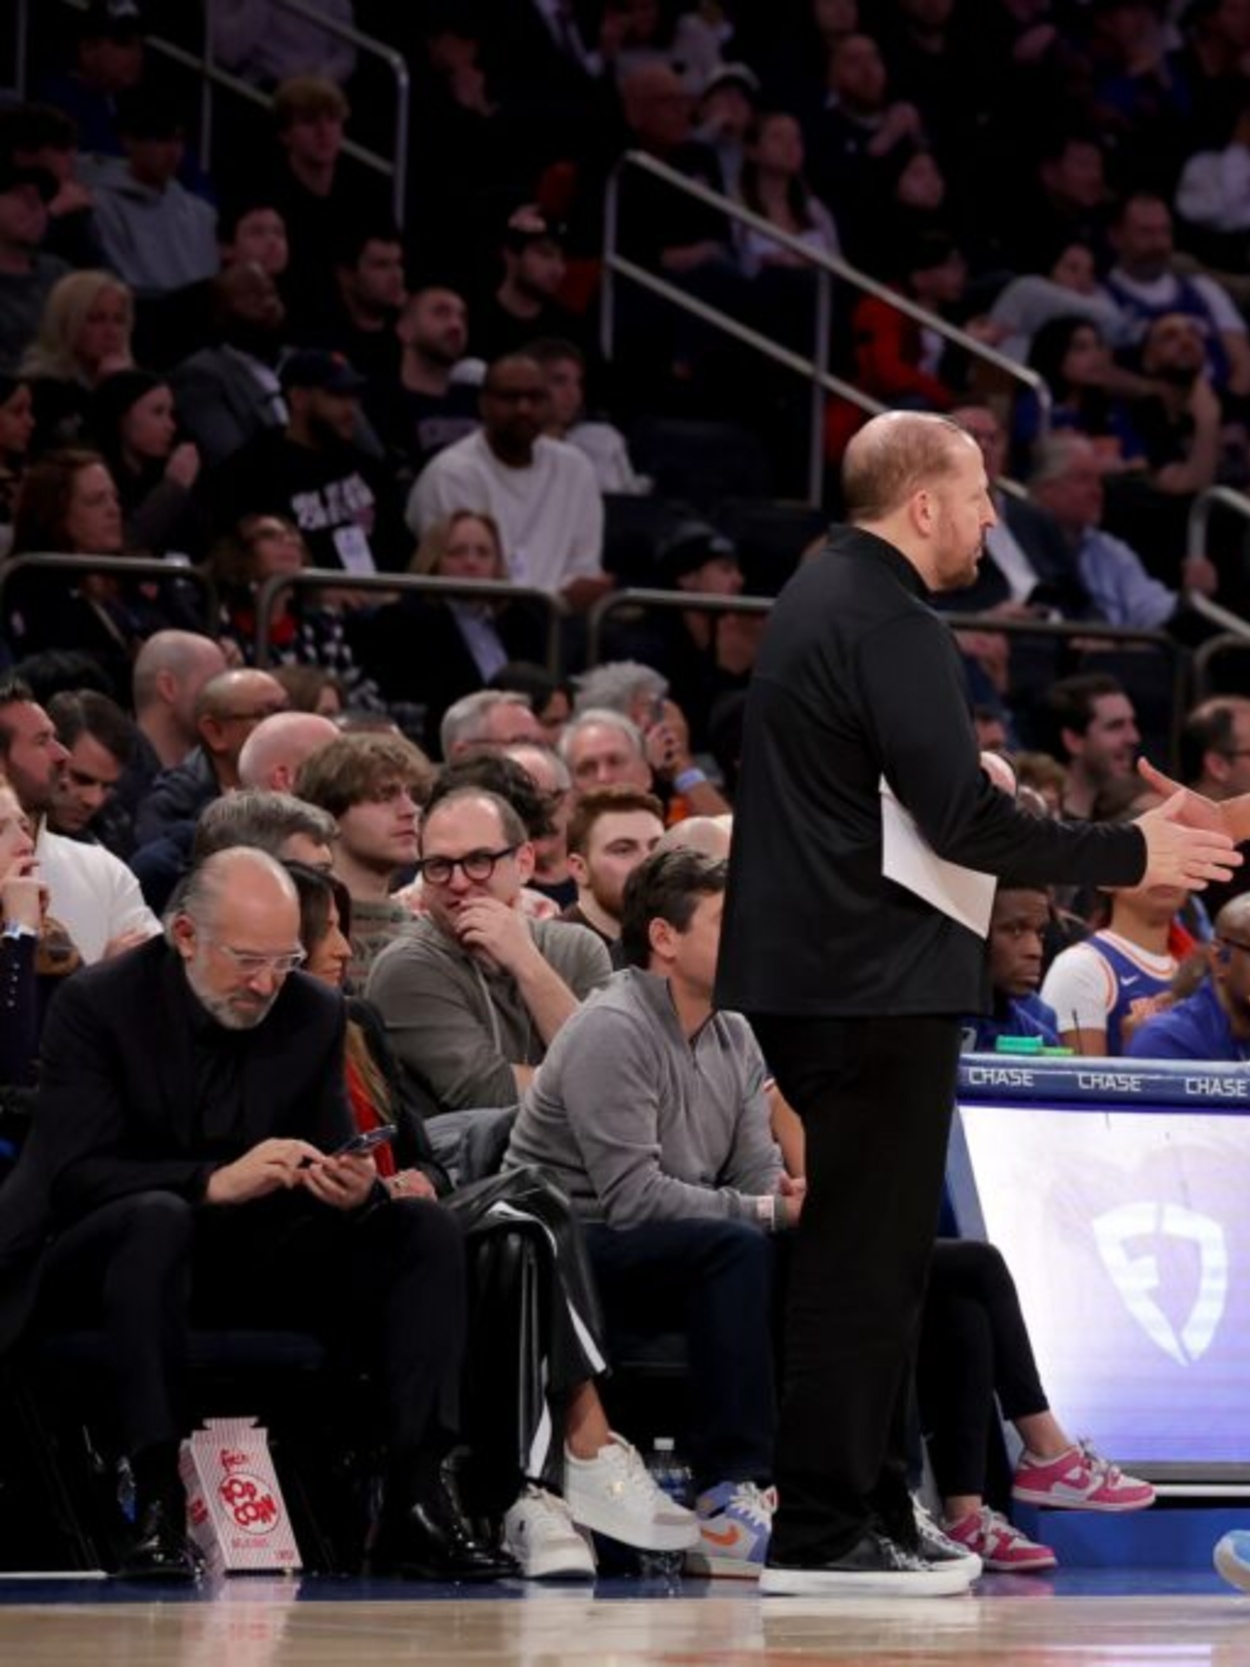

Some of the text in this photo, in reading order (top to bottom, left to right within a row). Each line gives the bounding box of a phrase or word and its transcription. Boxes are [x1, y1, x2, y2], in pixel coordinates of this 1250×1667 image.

[968, 1067, 1035, 1087] CHASE
[1077, 1072, 1142, 1092] CHASE
[1184, 1077, 1248, 1097] CHASE
